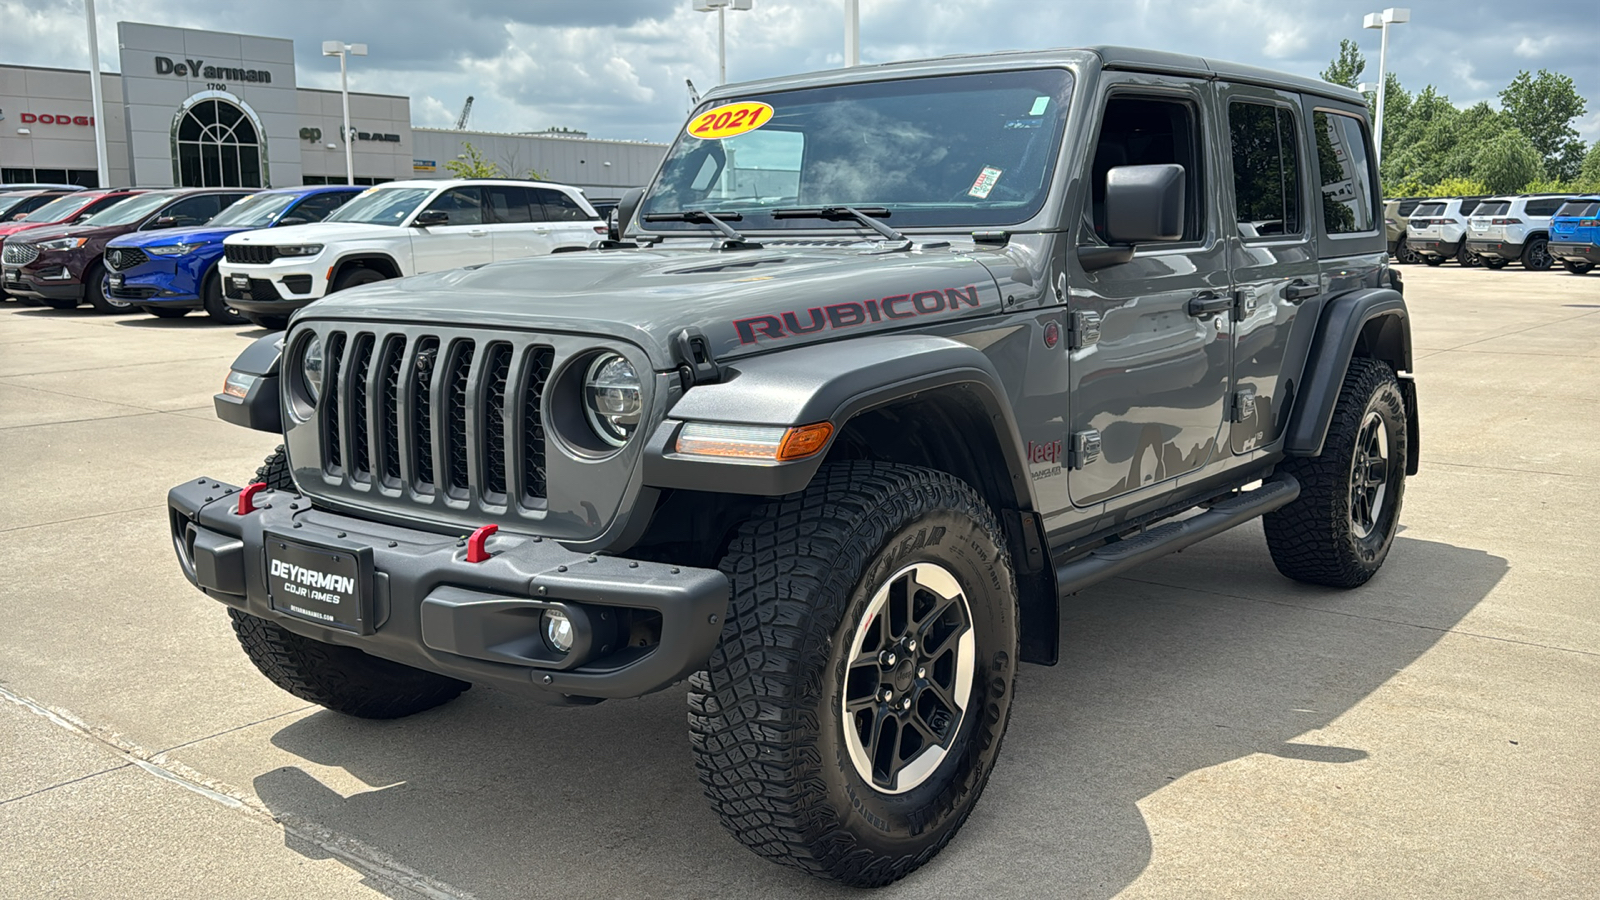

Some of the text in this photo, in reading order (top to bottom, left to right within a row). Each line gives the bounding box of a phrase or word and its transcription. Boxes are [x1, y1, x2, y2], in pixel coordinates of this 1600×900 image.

[155, 56, 271, 83] DeYarman
[207, 83, 226, 91] 1700
[694, 107, 764, 133] 2021
[299, 127, 322, 143] ep
[358, 132, 400, 142] RAM
[733, 285, 980, 346] RUBICON
[1027, 440, 1062, 464] Jeep
[271, 559, 354, 595] DEYARMAN
[311, 590, 340, 605] AMES
[290, 604, 334, 621] DEYARMANAMES.COM
